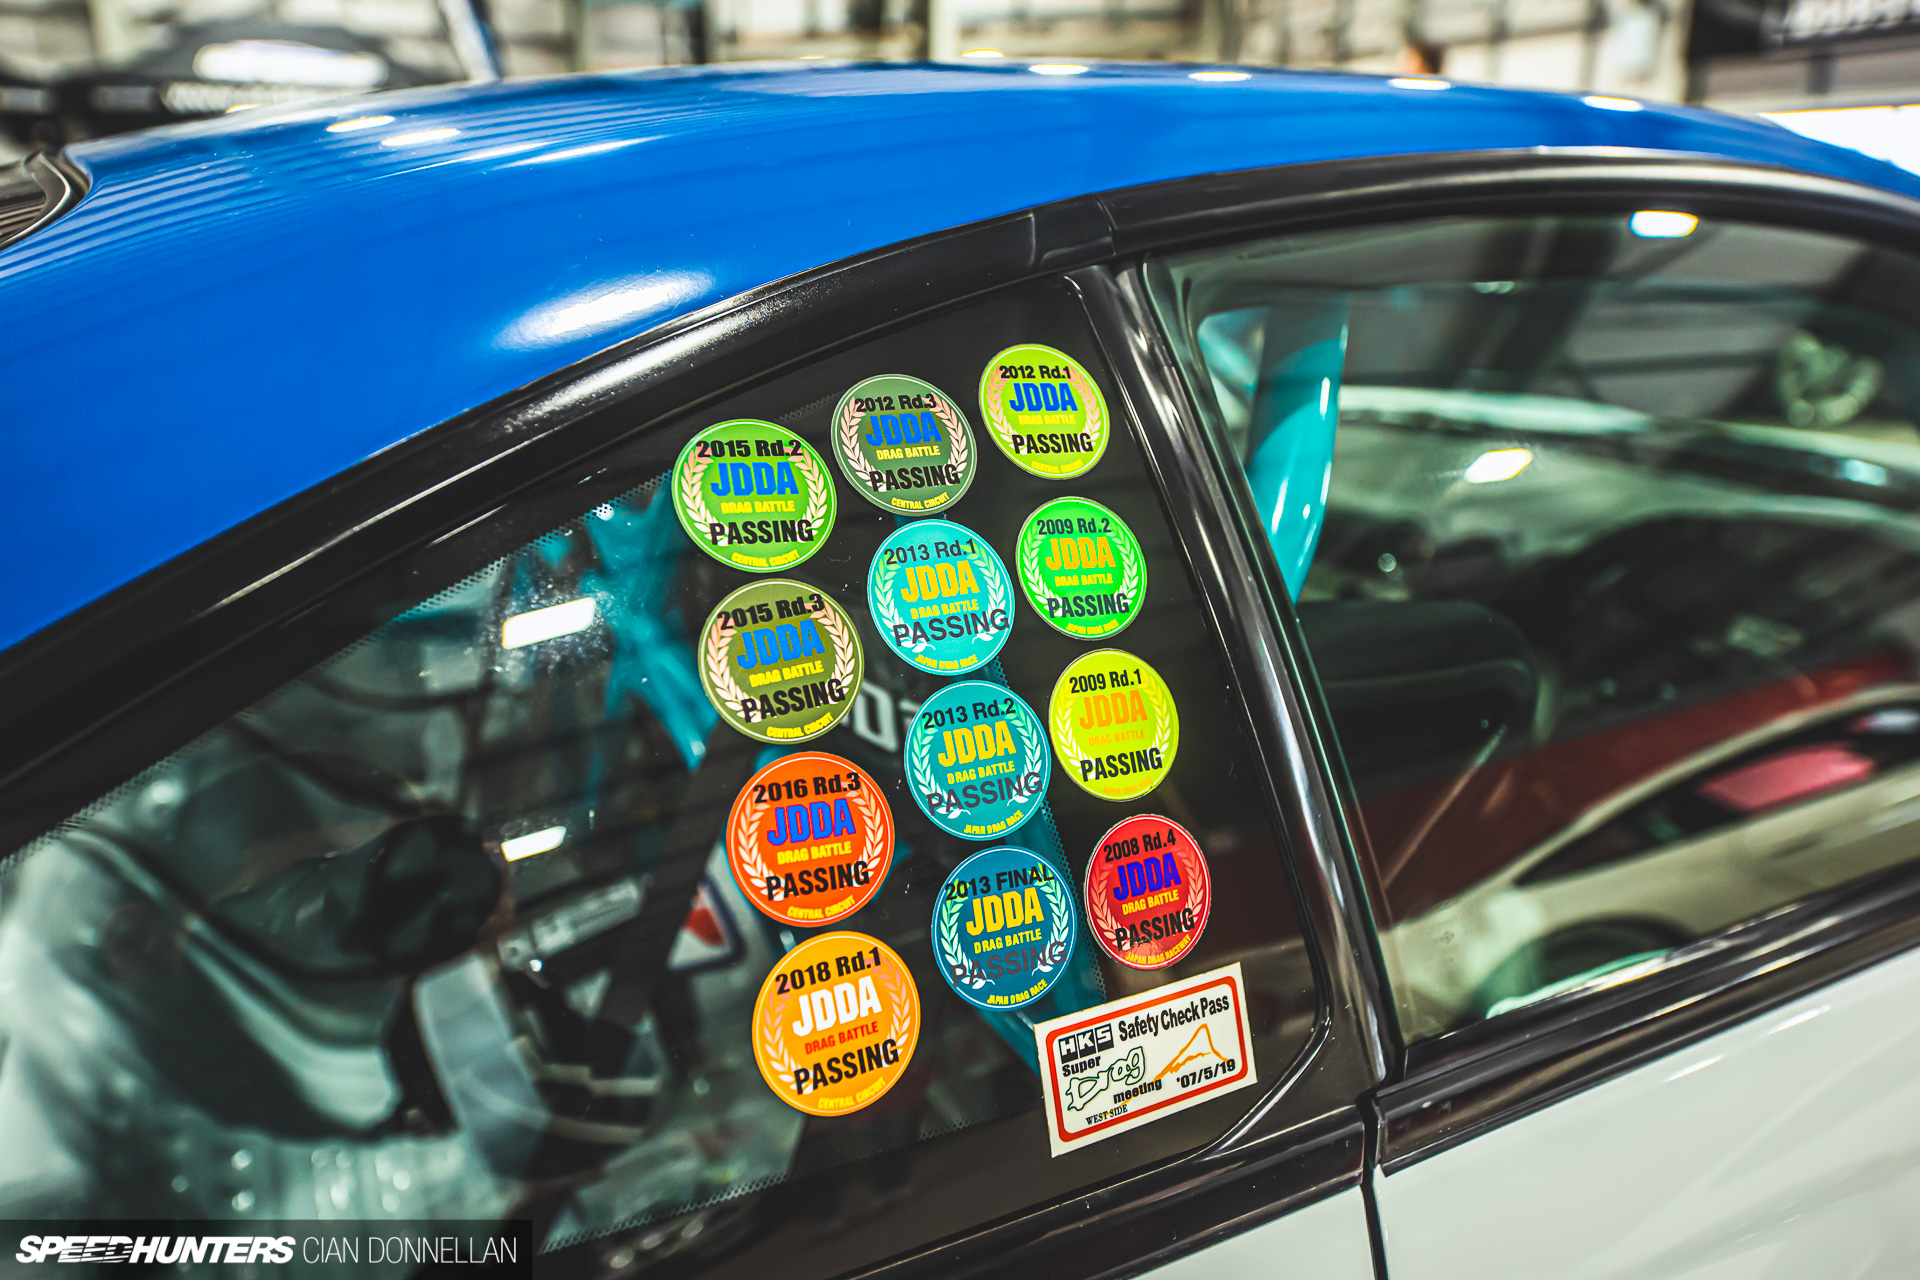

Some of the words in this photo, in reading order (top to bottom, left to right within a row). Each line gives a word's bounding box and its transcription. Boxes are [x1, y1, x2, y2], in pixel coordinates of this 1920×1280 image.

[999, 365, 1036, 379] 2012
[1038, 365, 1072, 379] Rd.1
[855, 396, 895, 412] 2012
[898, 394, 936, 409] Rd.3
[1009, 382, 1078, 412] JDDA
[865, 412, 943, 447] JDDA
[1012, 433, 1094, 454] PASSING
[696, 440, 751, 458] 2015
[755, 440, 803, 457] Rd.2
[876, 449, 904, 460] DRAG
[905, 446, 941, 458] BATTLE
[710, 462, 799, 496] JDDA
[869, 464, 960, 492] PASSING
[721, 502, 753, 514] DRAG
[755, 500, 795, 513] BATTLE
[891, 497, 924, 509] CENTRAL
[924, 492, 950, 508] CIRCUIT
[710, 519, 814, 545] PASSING
[1037, 519, 1074, 535] 2009
[1077, 518, 1112, 533] Rd.2
[731, 552, 769, 567] CENTRAL
[884, 544, 930, 565] 2013
[934, 538, 976, 558] Rd.1
[1045, 536, 1116, 570] JDDA
[901, 560, 980, 602] JDDA
[1054, 575, 1080, 586] DRAG
[1081, 573, 1113, 585] BATTLE
[717, 603, 773, 630] 2015
[776, 593, 825, 619] Rd.3
[910, 604, 940, 620] DRAG
[941, 599, 979, 615] BATTLE
[1047, 593, 1129, 618] PASSING
[893, 608, 1009, 647] PASSING
[736, 619, 826, 670] JDDA
[749, 669, 782, 687] DRAG
[782, 660, 824, 680] BATTLE
[1069, 673, 1106, 693] 2009
[1109, 669, 1142, 688] Rd.1
[741, 678, 846, 723] PASSING
[922, 706, 968, 729] 2013
[972, 698, 1016, 720] Rd.2
[1079, 689, 1148, 730] JDDA
[766, 726, 804, 738] CENTRAL
[938, 720, 1016, 767] JDDA
[1088, 734, 1112, 747] DRAG
[1114, 728, 1145, 742] BATTLE
[947, 768, 976, 785] DRAG
[978, 761, 1015, 778] BATTLE
[1080, 748, 1162, 782] PASSING
[754, 779, 808, 804] 2016
[813, 772, 861, 796] Rd.3
[926, 771, 1043, 816] PASSING
[767, 798, 856, 846] JDDA
[777, 847, 809, 865] DRAG
[810, 841, 852, 859] BATTLE
[1103, 837, 1140, 863] 2008
[1142, 829, 1176, 852] Rd.4
[766, 861, 869, 901] PASSING
[944, 876, 991, 901] 2013
[996, 864, 1054, 891] FINAL
[1113, 852, 1182, 901] JDDA
[787, 905, 824, 919] CENTRAL
[825, 895, 856, 917] CIRCUIT
[966, 887, 1044, 936] JDDA
[1122, 898, 1146, 916] DRAG
[1147, 889, 1179, 908] BATTLE
[974, 937, 1003, 954] DRAG
[1005, 928, 1042, 947] BATTLE
[1115, 908, 1195, 951] PASSING
[951, 941, 1067, 987] PASSING
[1126, 951, 1146, 964] JAPAN
[1148, 953, 1165, 965] DRAG
[1165, 934, 1191, 959] RACEWAY
[775, 961, 831, 995] 2018
[835, 946, 881, 977] Rd.1
[792, 975, 882, 1037] JDDA
[1010, 990, 1029, 1004] DRAG
[1029, 978, 1048, 996] RACE
[1118, 1012, 1159, 1042] Safety
[1160, 1001, 1200, 1030] Check
[1199, 995, 1230, 1019] Pass
[805, 1035, 836, 1055] DRAG
[838, 1021, 879, 1044] BATTLE
[1058, 1023, 1114, 1064] HKS
[793, 1038, 899, 1095] PASSING
[1062, 1056, 1101, 1078] Super
[818, 1096, 855, 1109] CENTRAL
[855, 1076, 886, 1104] CIRCUIT
[1113, 1079, 1162, 1104] meeting
[1086, 1111, 1109, 1125] WEST
[1109, 1104, 1128, 1118] SIDE
